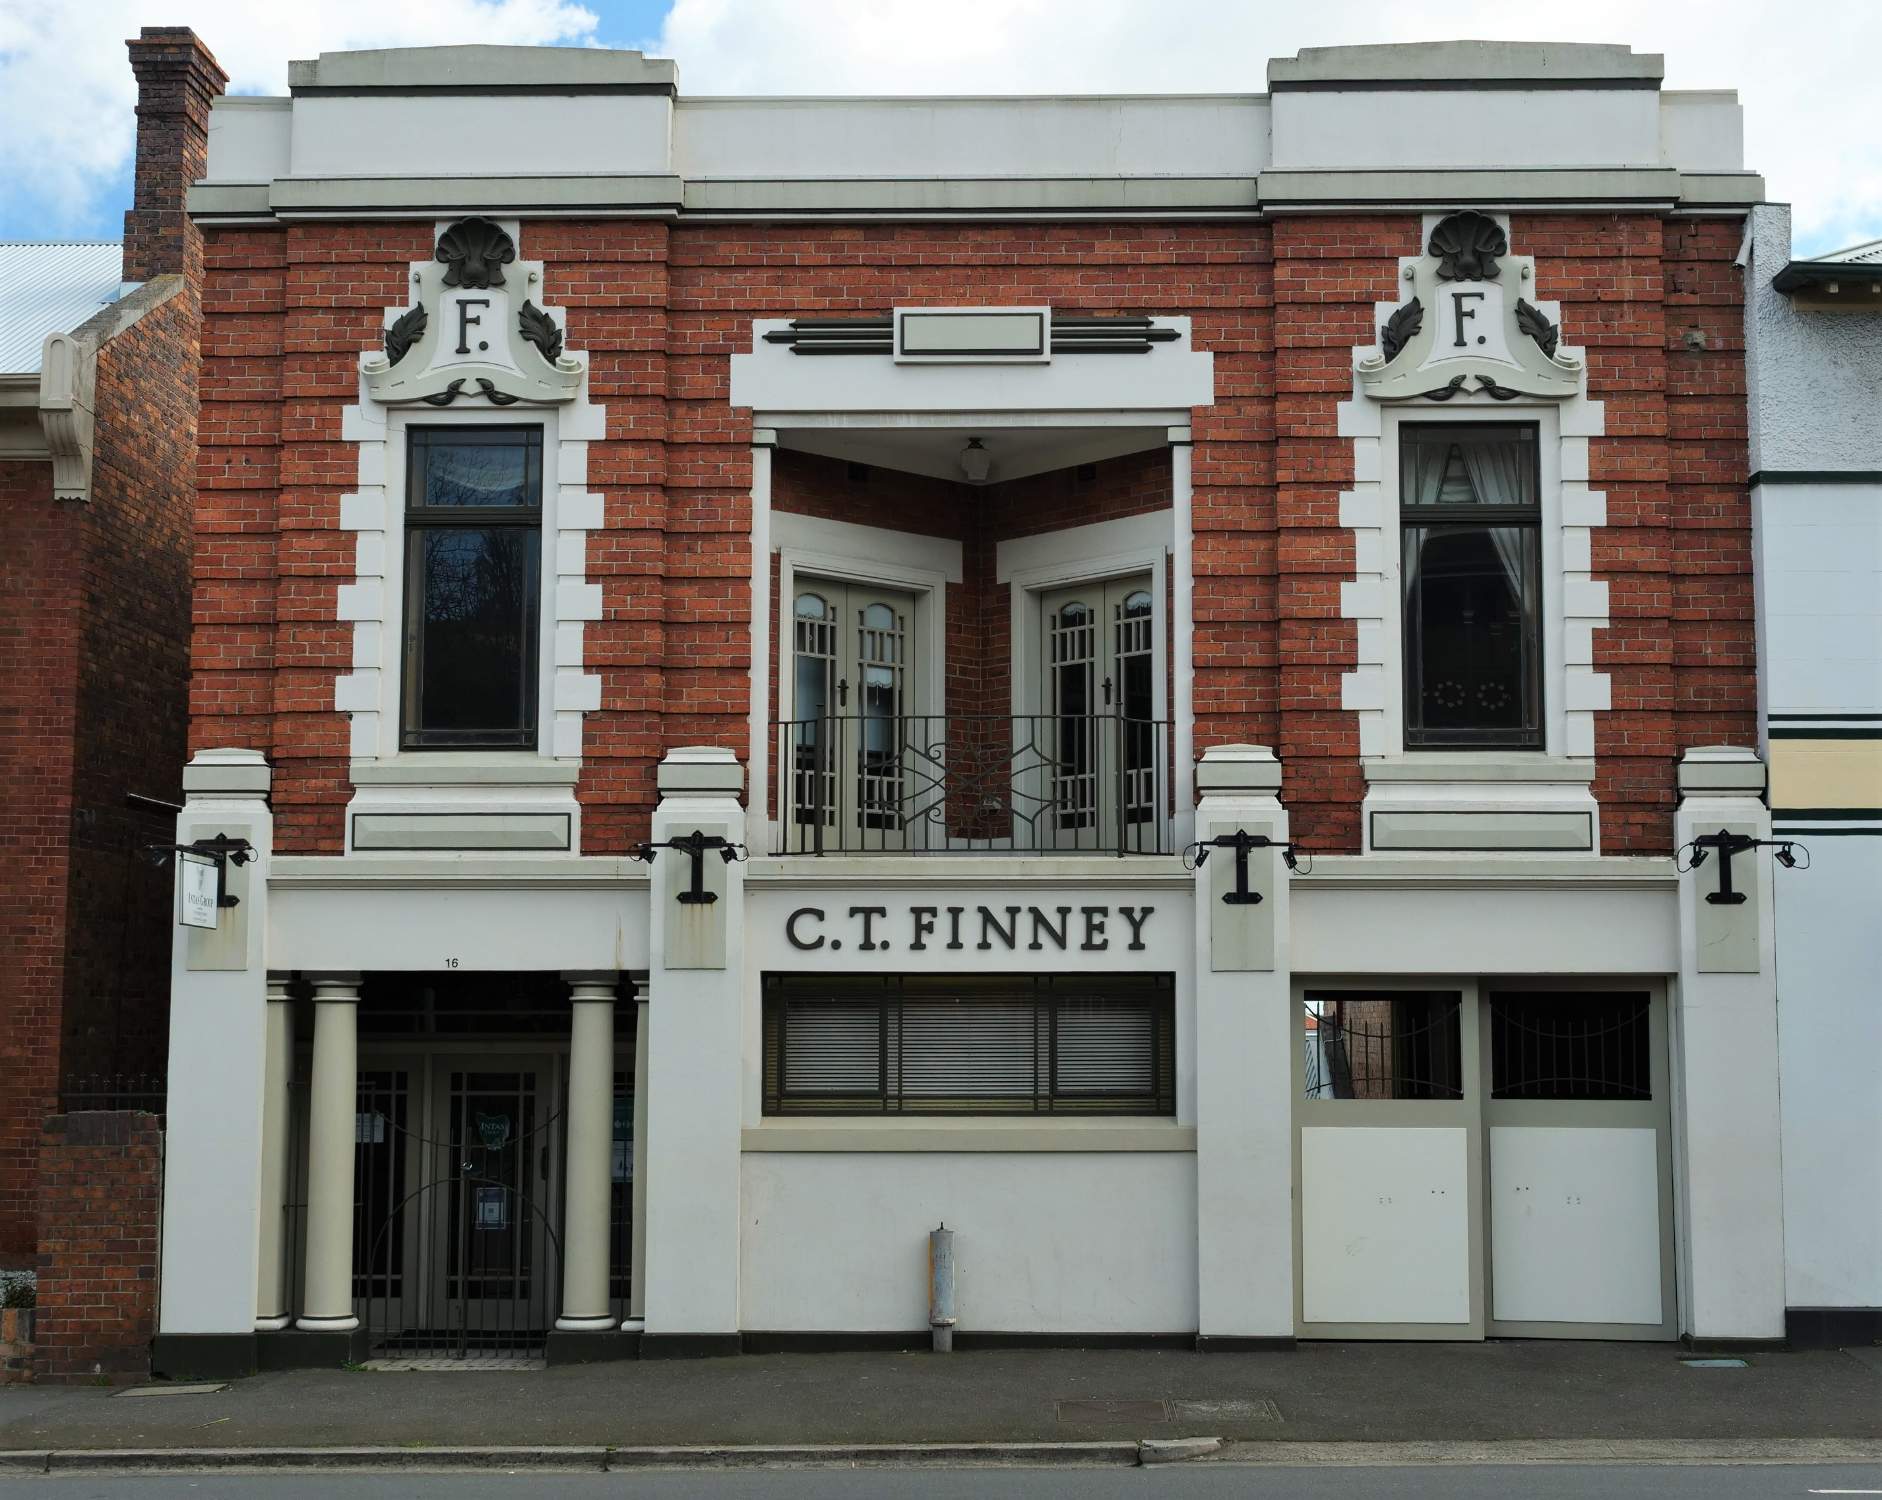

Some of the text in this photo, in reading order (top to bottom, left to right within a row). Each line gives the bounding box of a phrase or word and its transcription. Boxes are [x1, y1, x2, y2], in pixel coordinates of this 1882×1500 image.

[456, 299, 489, 354] F.
[1451, 292, 1486, 347] F.
[785, 906, 1155, 951] C.T. FINNEY
[445, 958, 459, 968] 16
